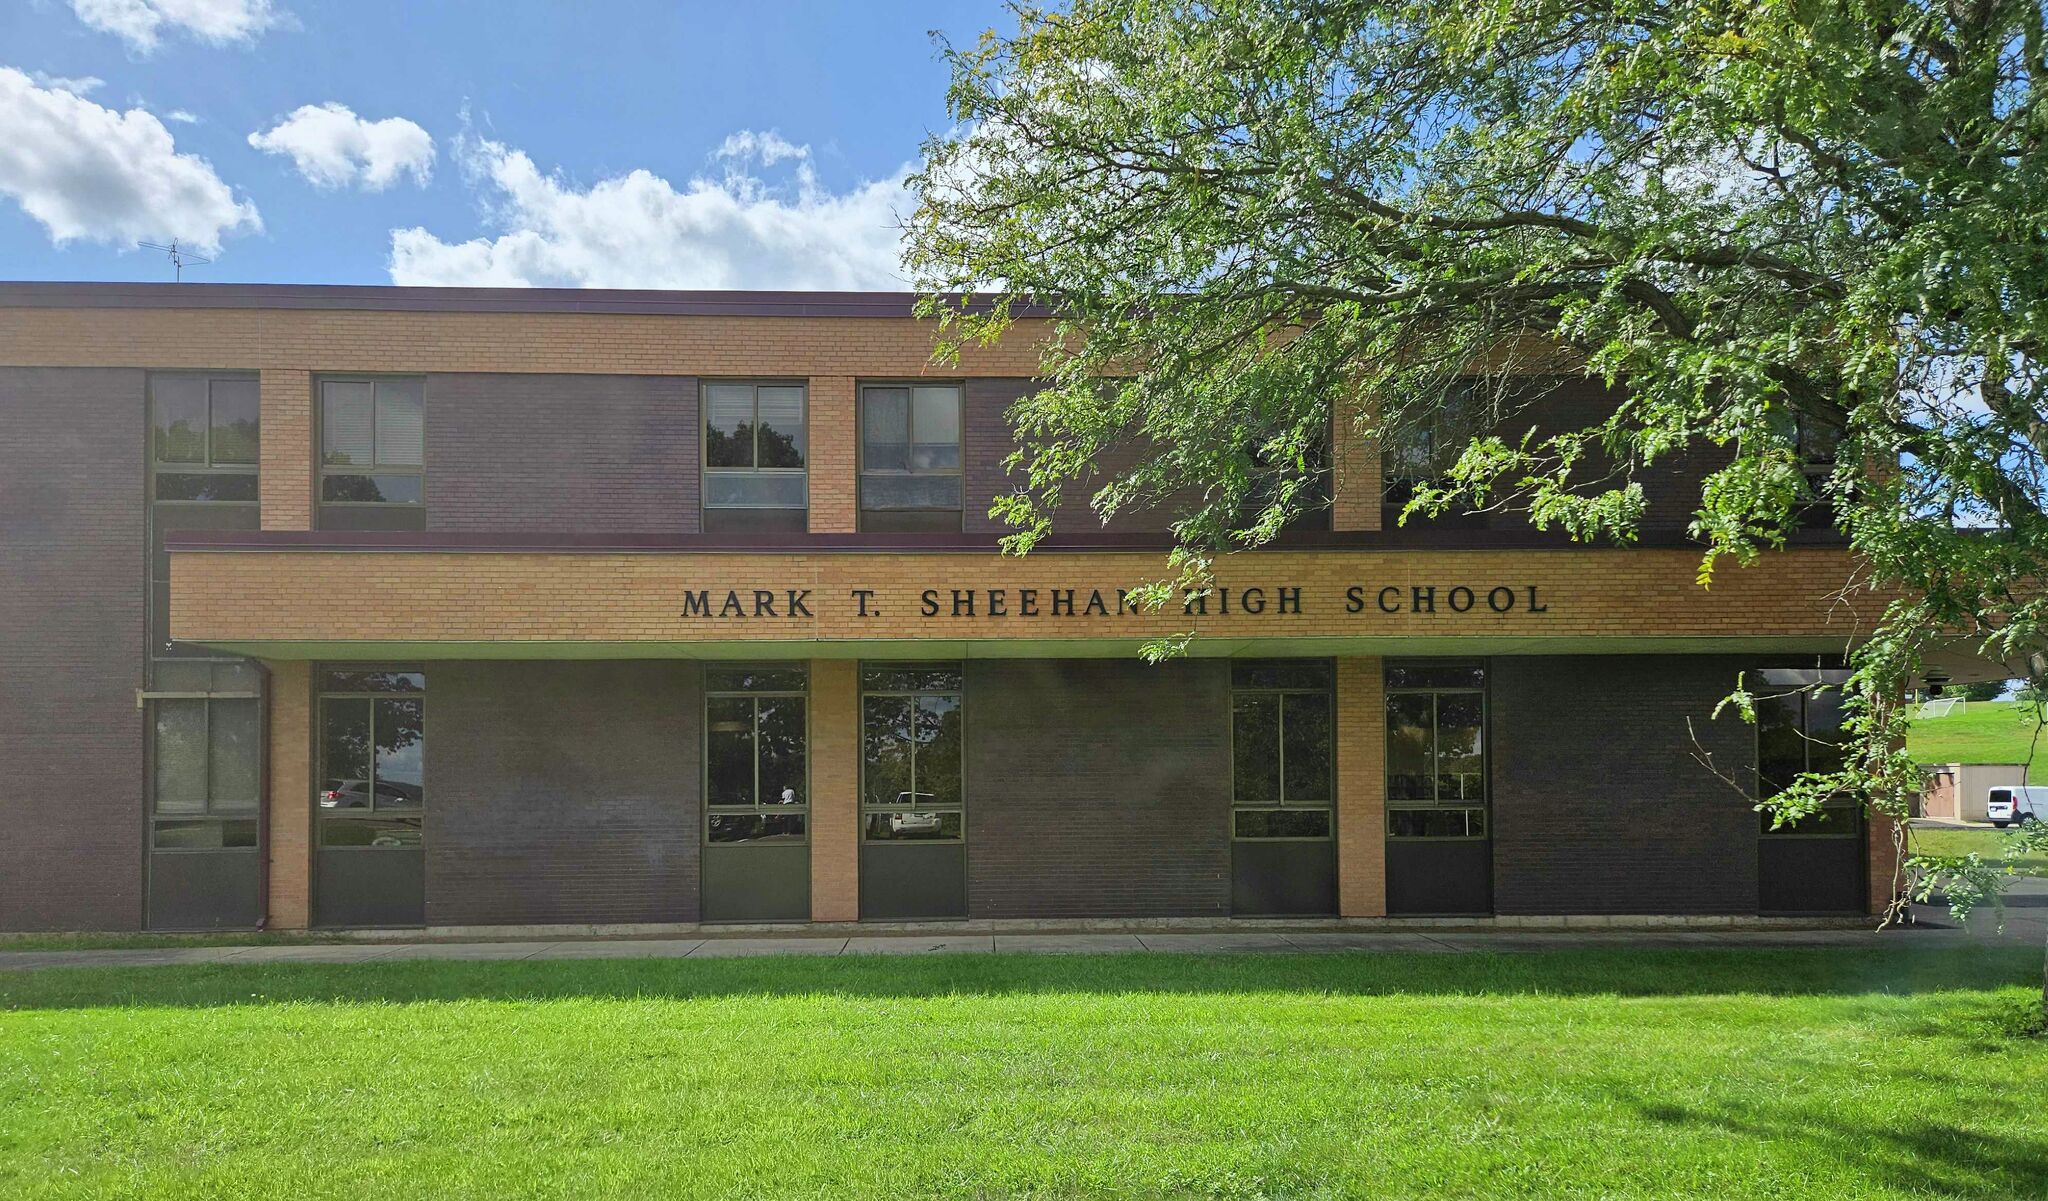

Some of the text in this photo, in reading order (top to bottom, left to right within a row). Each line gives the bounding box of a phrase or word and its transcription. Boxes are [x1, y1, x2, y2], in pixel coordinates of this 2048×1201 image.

[681, 585, 1549, 617] MARK T. SHEEHAN HIGH SCHOOL
